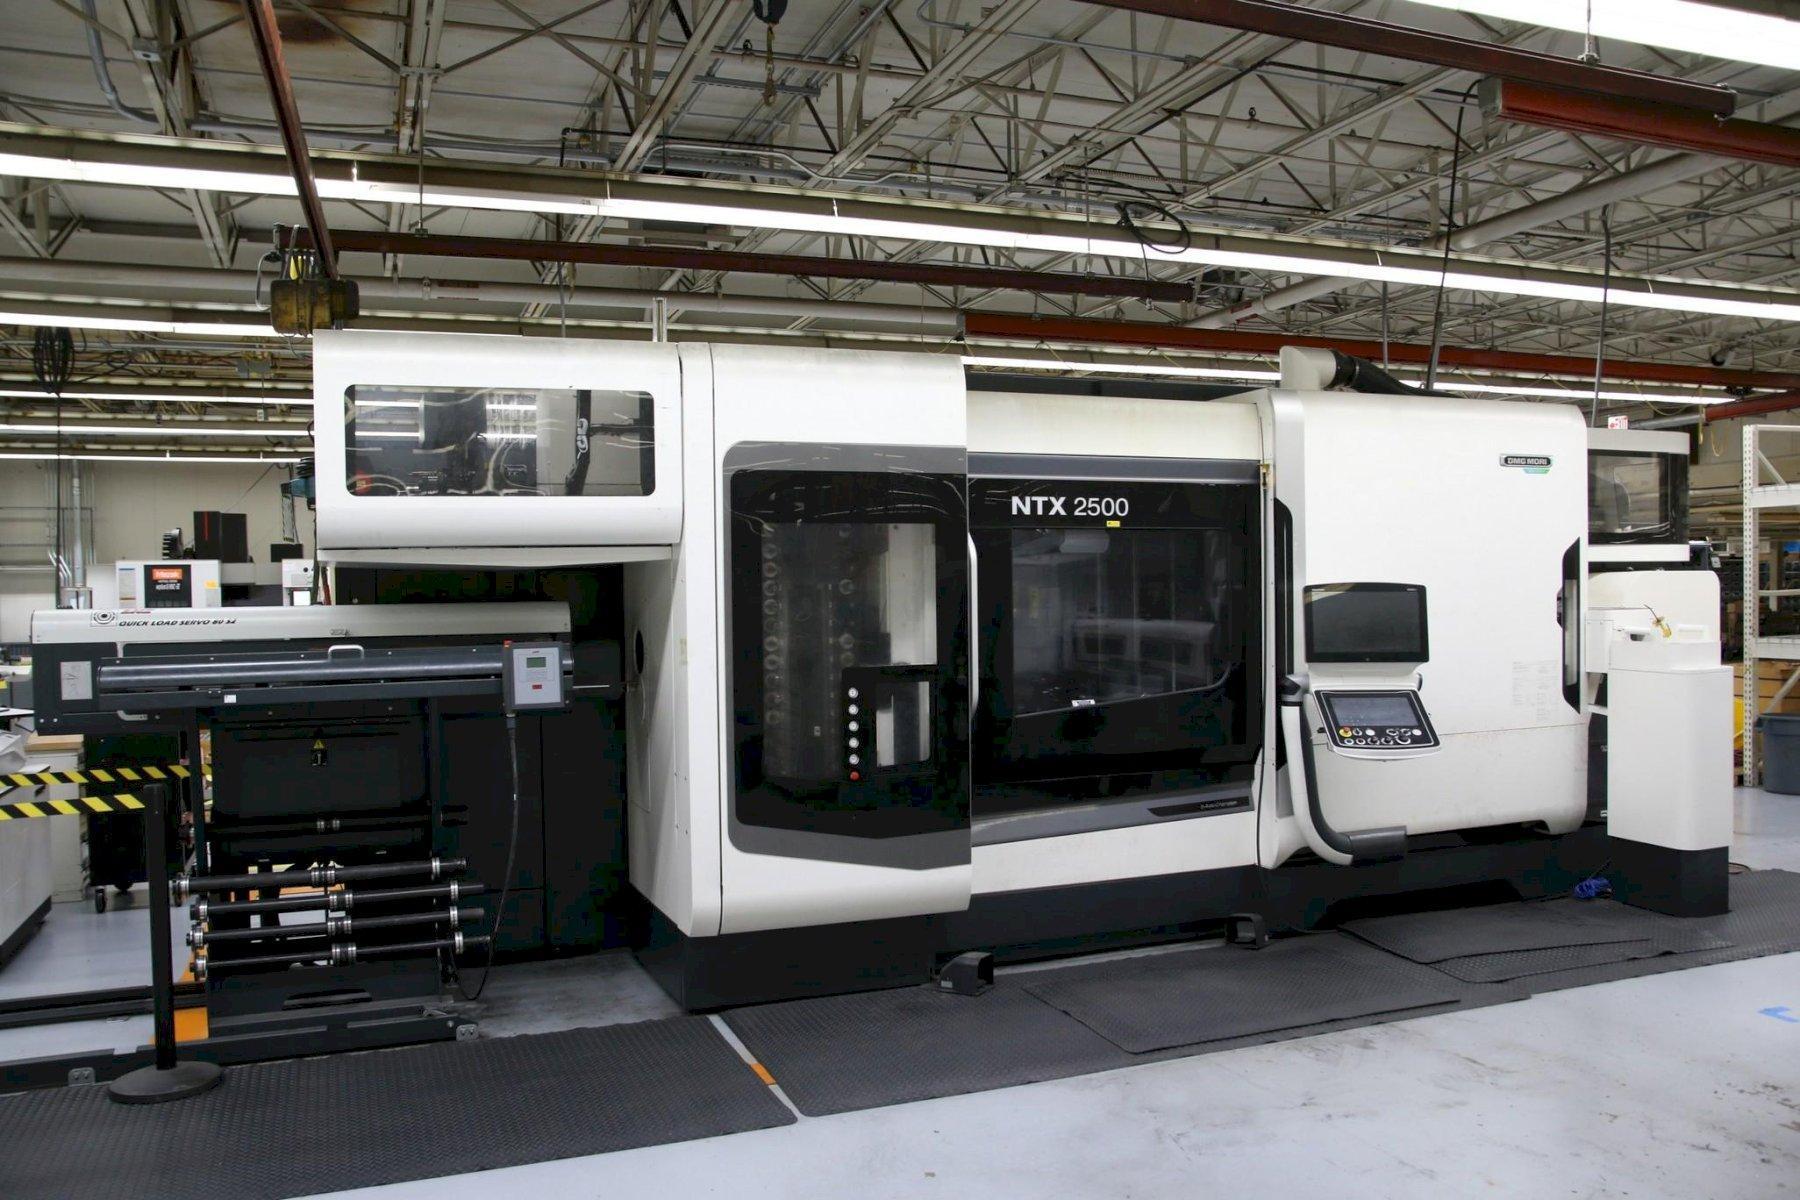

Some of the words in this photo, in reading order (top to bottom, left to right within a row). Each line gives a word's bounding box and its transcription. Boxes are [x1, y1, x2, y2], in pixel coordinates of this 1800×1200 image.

[1527, 457, 1548, 465] MORI
[1011, 496, 1067, 516] NTX
[1073, 497, 1129, 517] 2500
